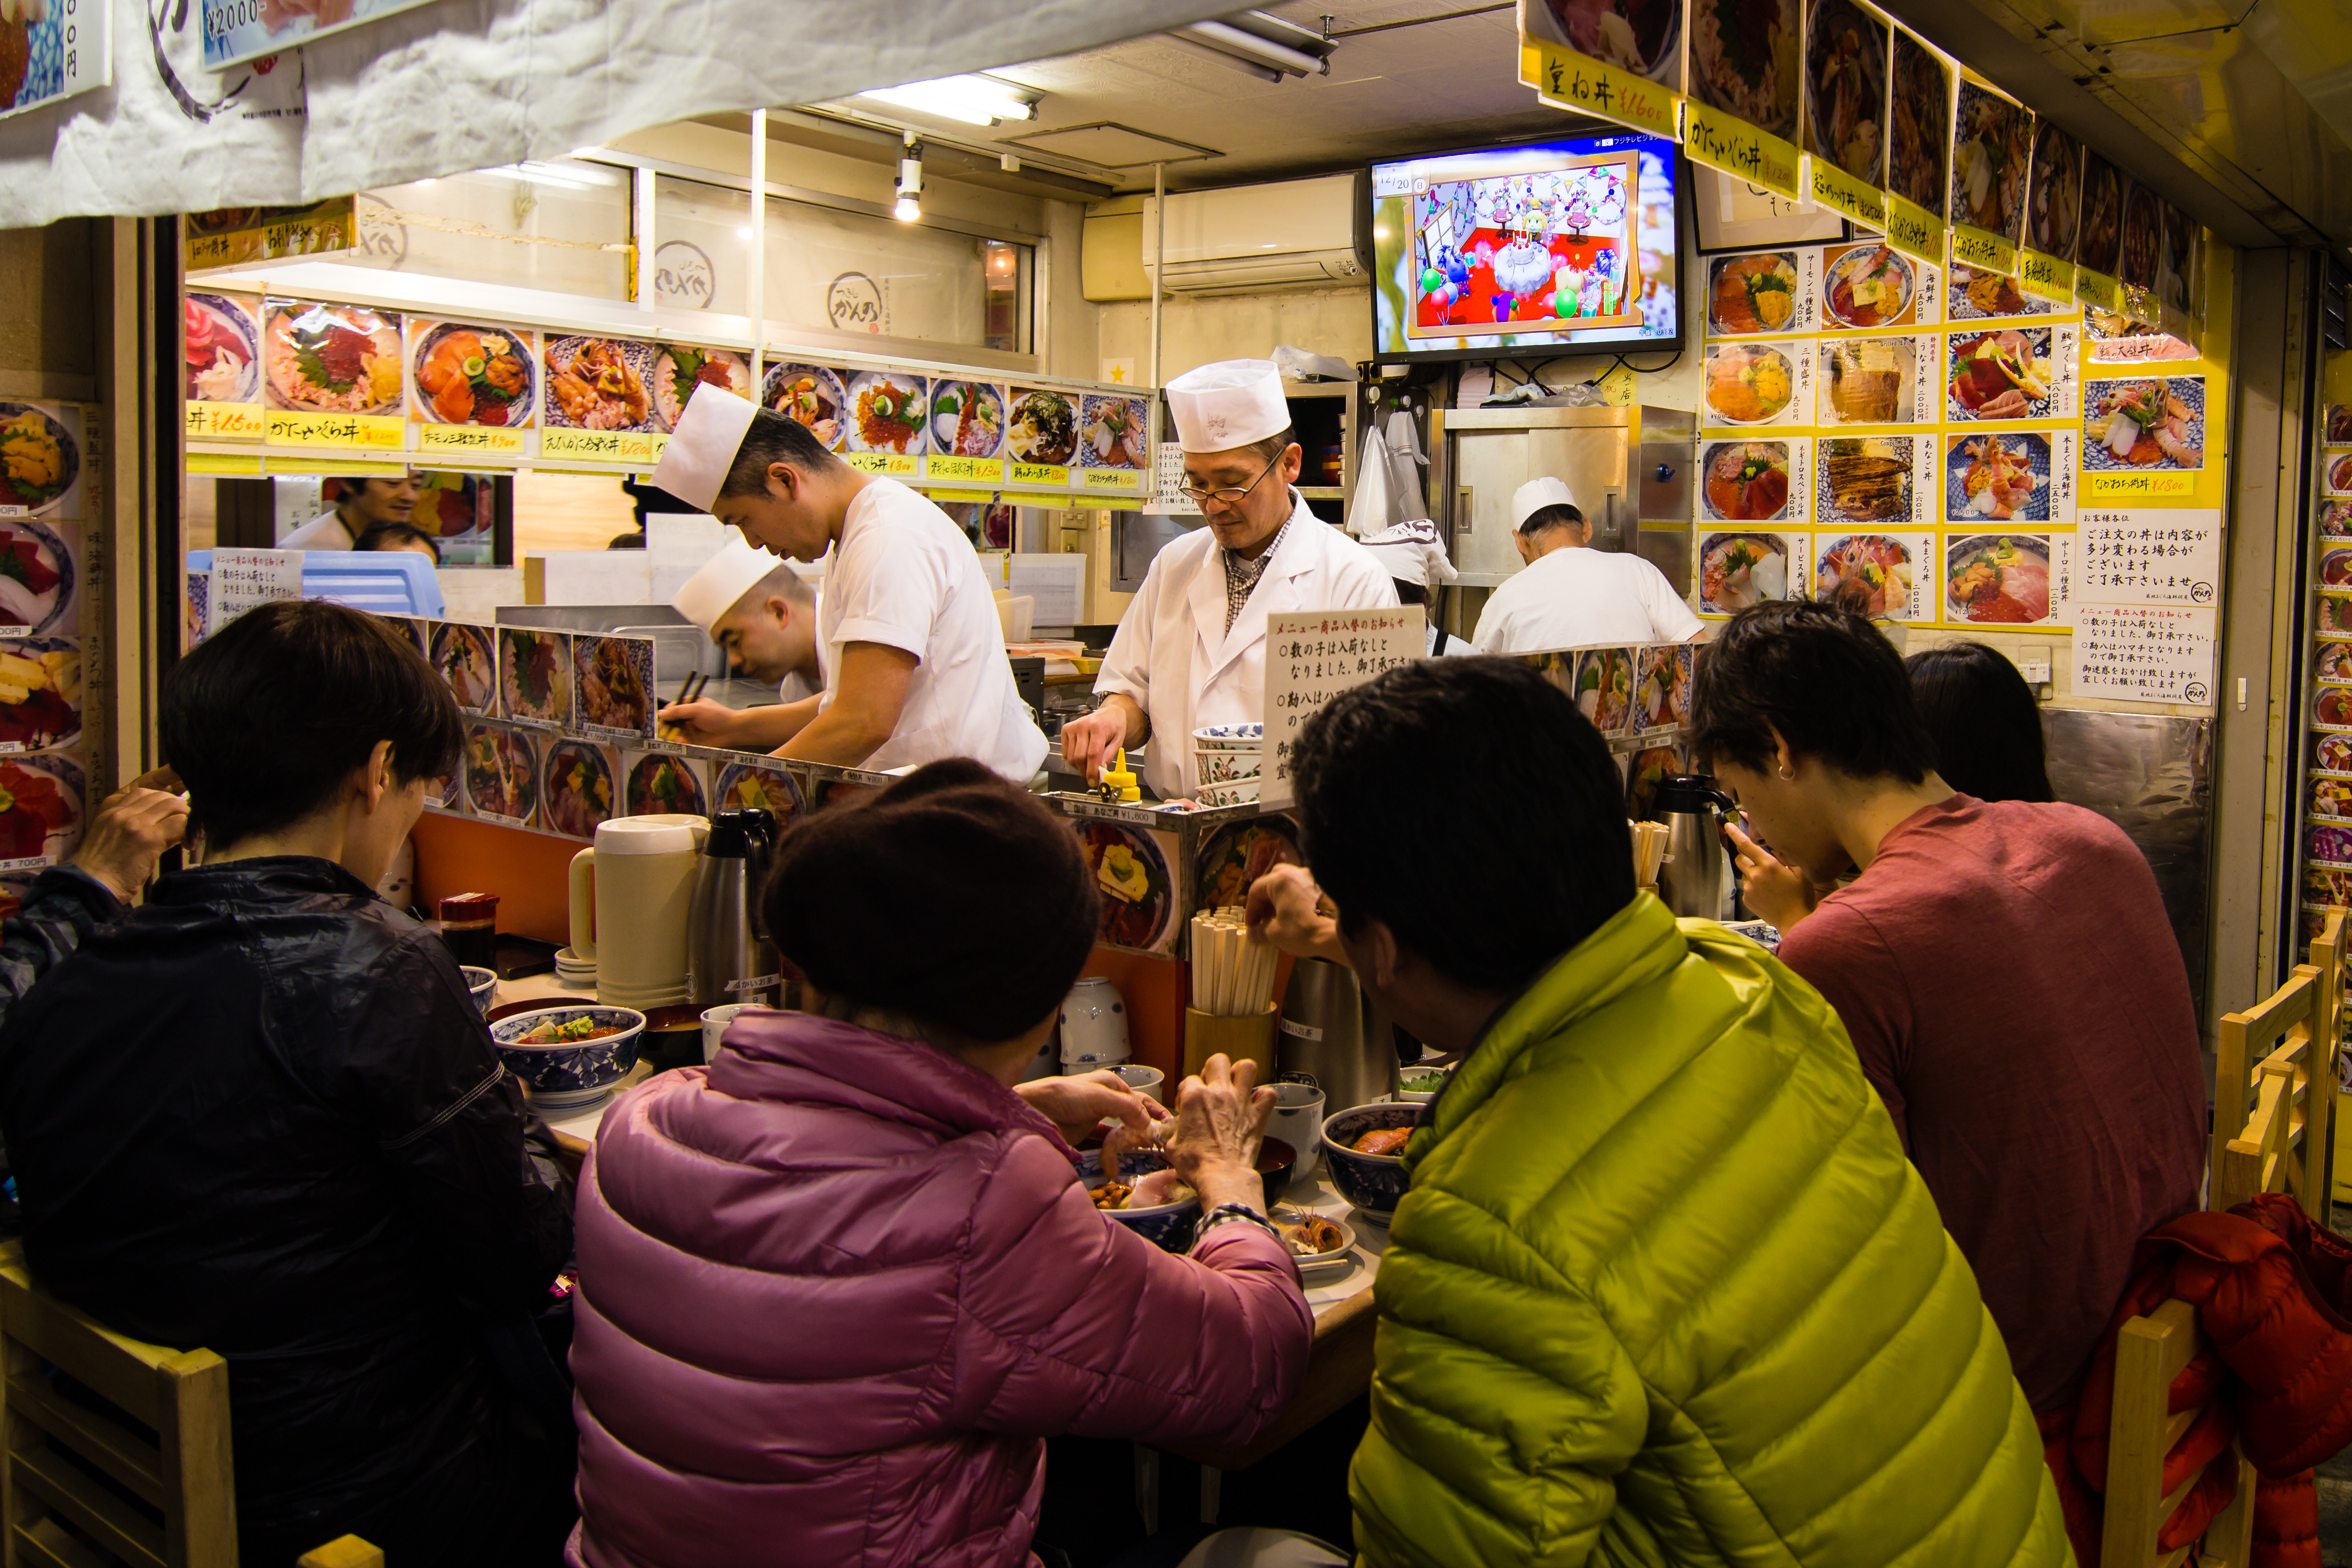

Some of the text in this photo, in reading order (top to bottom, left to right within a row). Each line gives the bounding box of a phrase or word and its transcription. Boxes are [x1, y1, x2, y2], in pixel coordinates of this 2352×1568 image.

[1549, 57, 1614, 111] 重ね丼
[1380, 174, 1409, 189] 12/20
[1805, 254, 1815, 324] サーモン三種盛丼
[1925, 266, 1936, 304] 海鮮丼
[1800, 347, 1810, 390] 三種盛丼
[1917, 342, 1927, 386] うなぎ丼
[852, 456, 887, 474] いくら丼
[1923, 440, 1932, 481] あなご丼
[2061, 435, 2072, 500] 本まぐろ海鮮丼
[2095, 477, 2150, 491] なかおち得丼
[2084, 514, 2130, 522] お客様各位
[2088, 529, 2208, 542] ご注文の丼は内容が
[2087, 542, 2193, 557] 多少変わる場合が
[1922, 537, 1931, 582] 本まぐろ丼
[2087, 559, 2150, 571] ございます
[2060, 540, 2070, 602] 中トロ三種盛丼
[2087, 574, 2192, 587] ご了承下さいませ
[2080, 608, 2193, 619] メニュー商品入替のお知らせ
[1276, 616, 1405, 635] メニュー商品入替のお知らせ
[2090, 653, 2168, 664] ので御了承下さい。
[2082, 664, 2197, 679] 御迷惑をおかけ致しますが
[2082, 675, 2176, 689] 宜しくお願い致します
[1094, 807, 1119, 818] あなご丼
[18, 857, 46, 868] 700円
[737, 976, 774, 989] かいお茶
